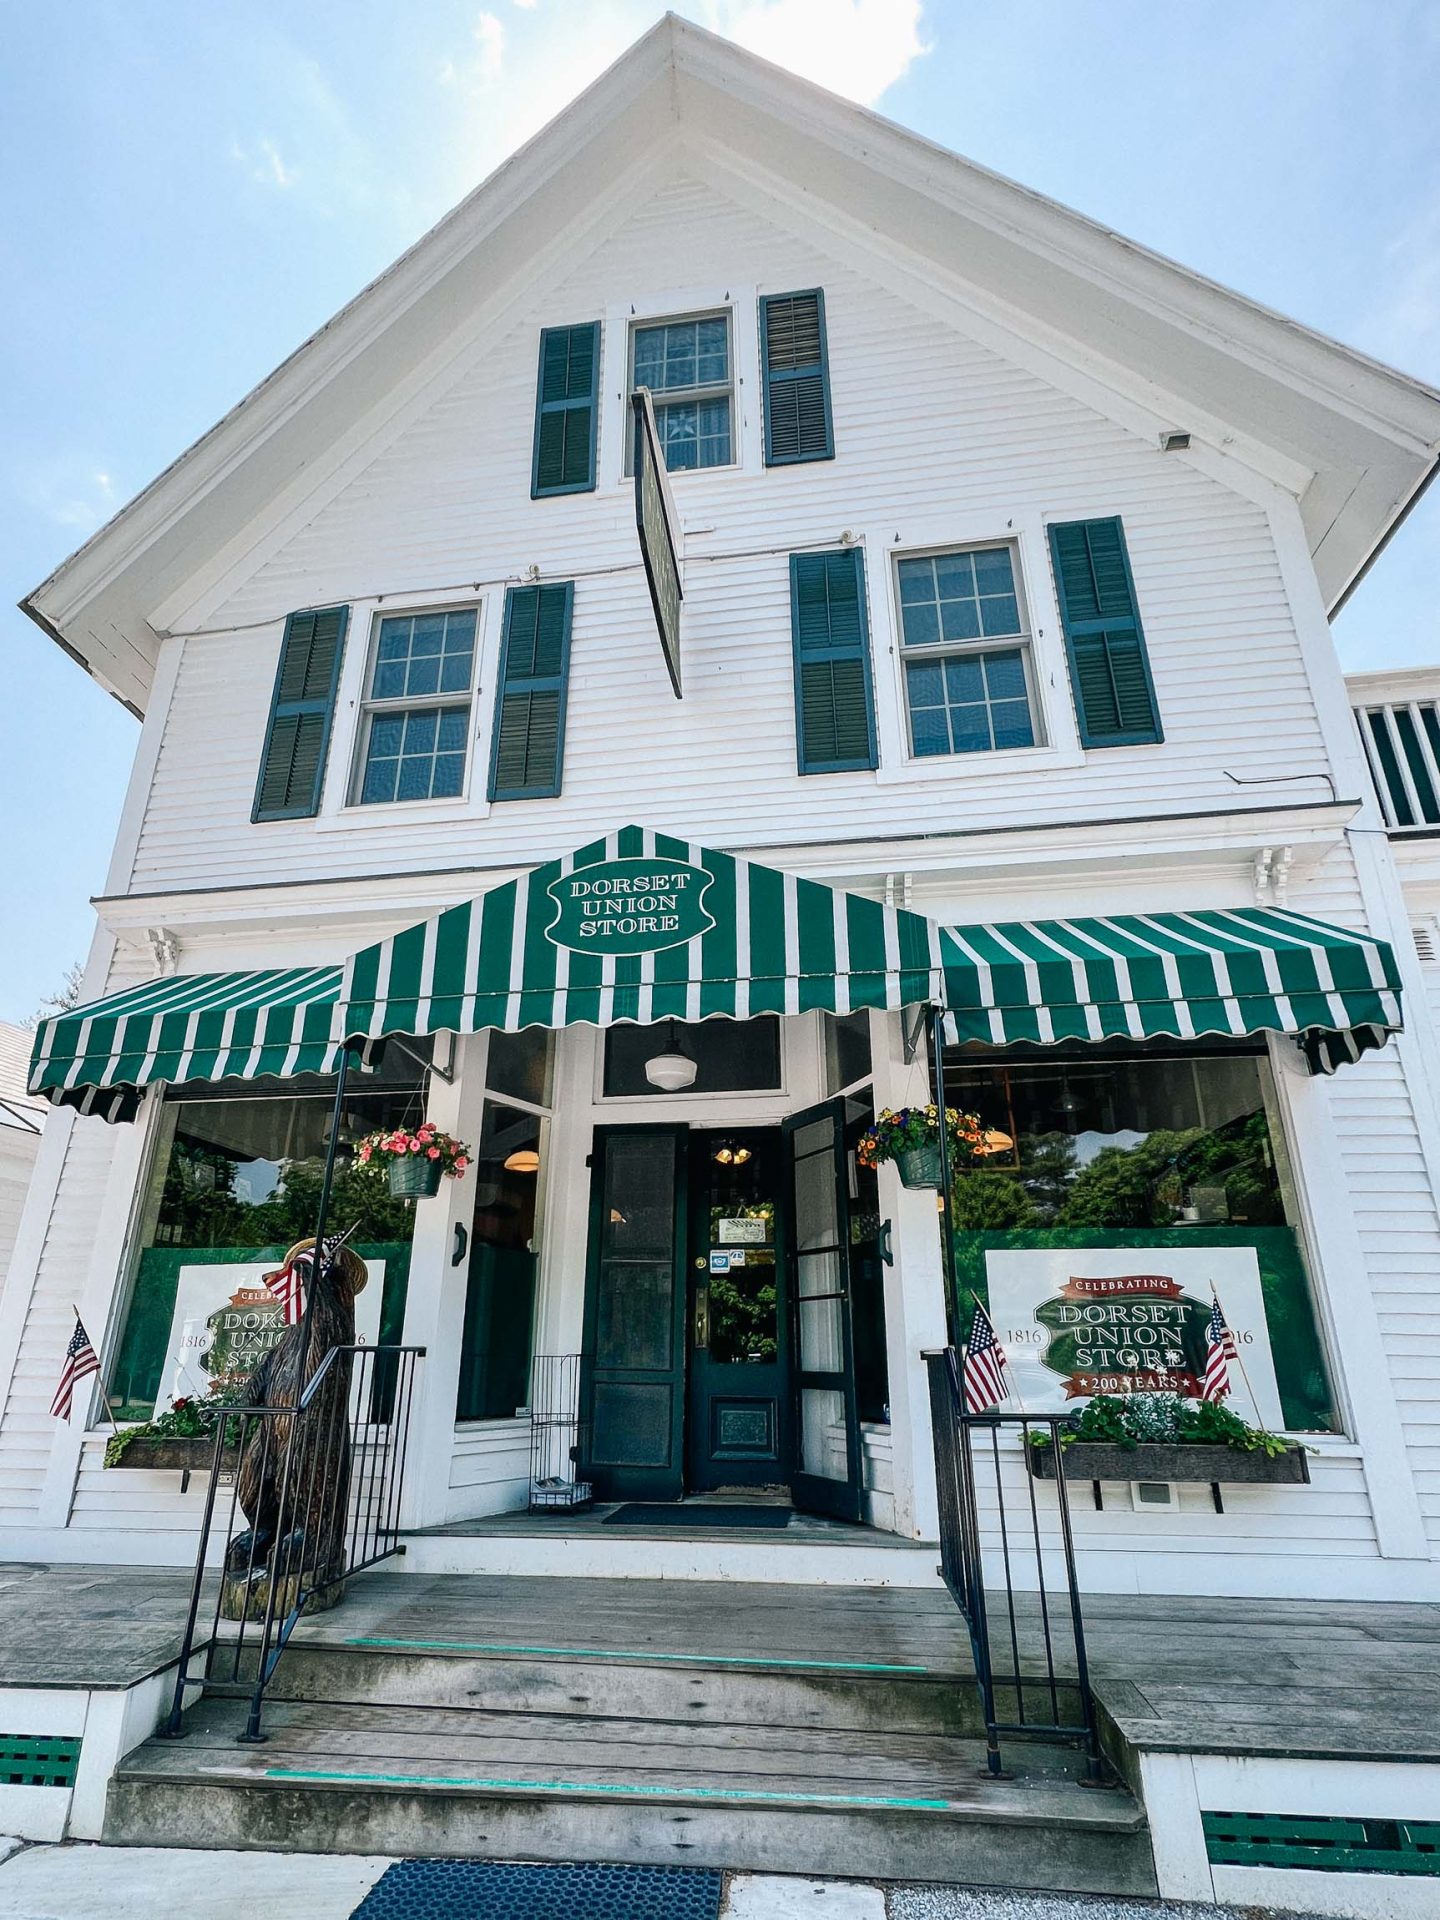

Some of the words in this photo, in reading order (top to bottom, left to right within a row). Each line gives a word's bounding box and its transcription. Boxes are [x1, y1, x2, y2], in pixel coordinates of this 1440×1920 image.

[570, 874, 690, 897] DORSET
[582, 895, 678, 916] UNION
[580, 915, 679, 937] STORE
[1075, 1279, 1169, 1291] CELEBRATING
[1058, 1305, 1192, 1323] DORSET
[181, 1335, 206, 1347] 1816
[1008, 1330, 1041, 1343] 1816
[1072, 1326, 1183, 1345] UNION
[1076, 1348, 1187, 1367] STORE
[1092, 1377, 1118, 1390] 200
[1121, 1374, 1178, 1388] YEARS
